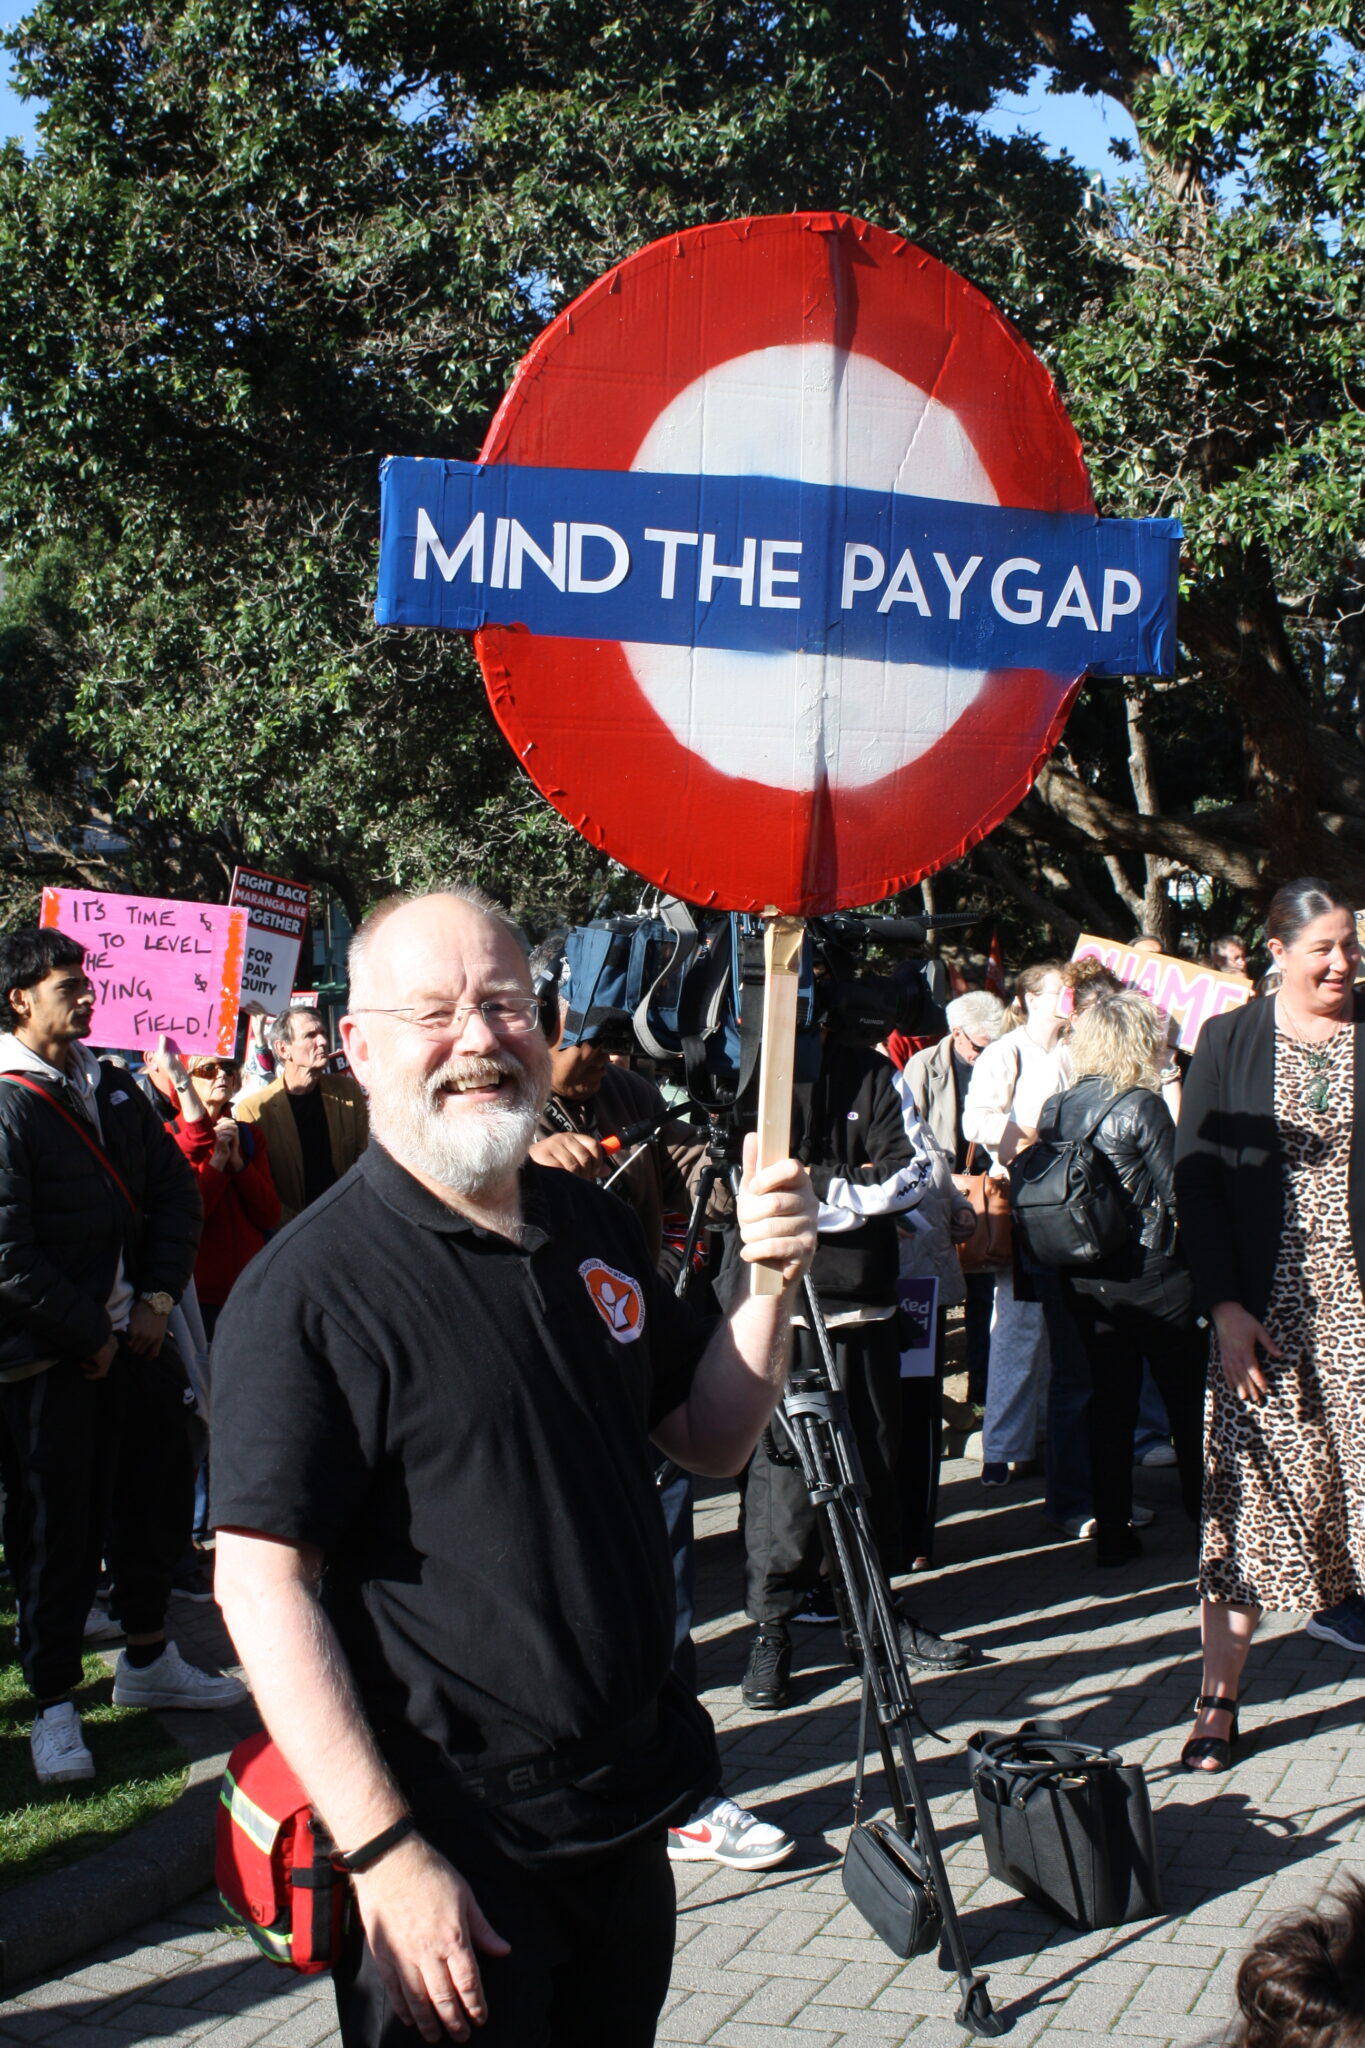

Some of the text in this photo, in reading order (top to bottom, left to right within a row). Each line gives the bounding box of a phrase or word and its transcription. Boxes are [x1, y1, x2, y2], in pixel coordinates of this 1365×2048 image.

[412, 507, 1143, 633] MIND THE PAY GAP
[238, 873, 308, 903] FIGHT BACK
[73, 899, 107, 922] IT'S
[126, 906, 176, 927] TIME
[234, 888, 307, 917] MARANGA AKE
[98, 932, 213, 954] TO LEVEL
[85, 952, 114, 972] HE
[247, 947, 273, 965] FOR
[246, 962, 270, 979] PAY
[241, 977, 277, 996] QUITY
[133, 1003, 214, 1038] FIELD!
